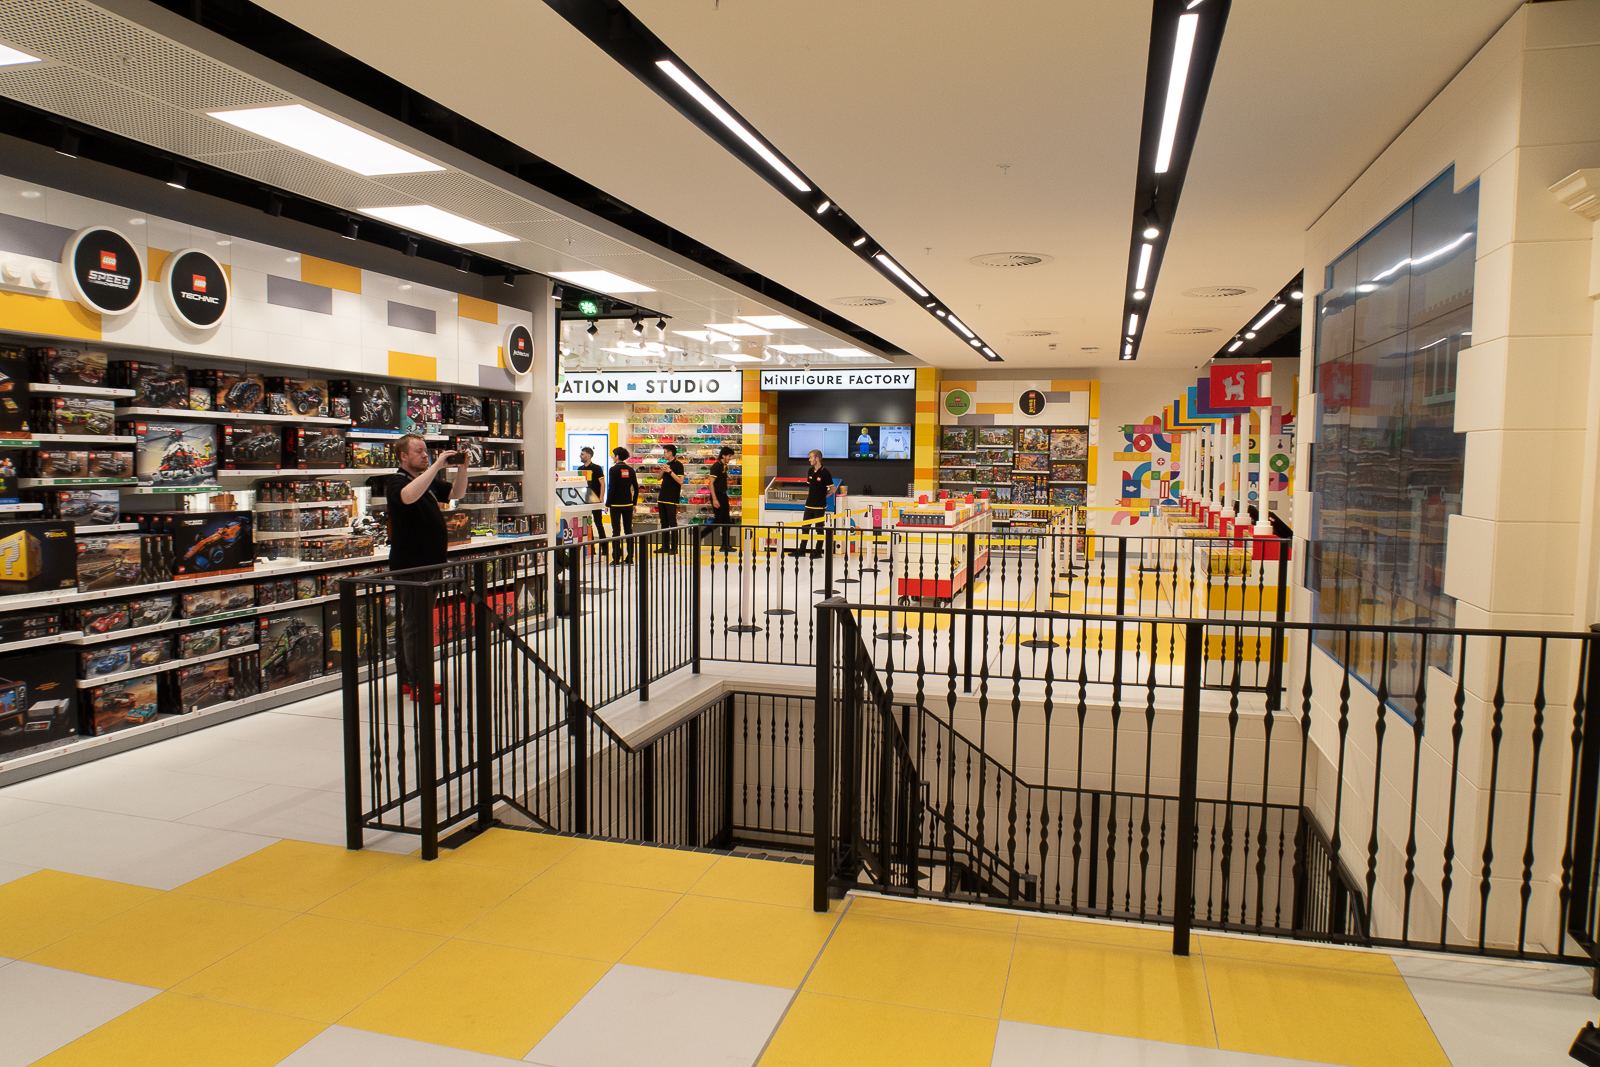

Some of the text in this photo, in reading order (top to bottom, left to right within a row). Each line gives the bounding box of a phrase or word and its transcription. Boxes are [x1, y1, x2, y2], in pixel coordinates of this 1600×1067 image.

[88, 270, 131, 286] SPEED
[180, 291, 220, 304] TECHNIC
[849, 374, 910, 384] FACTORY
[646, 379, 720, 394] STUDIO
